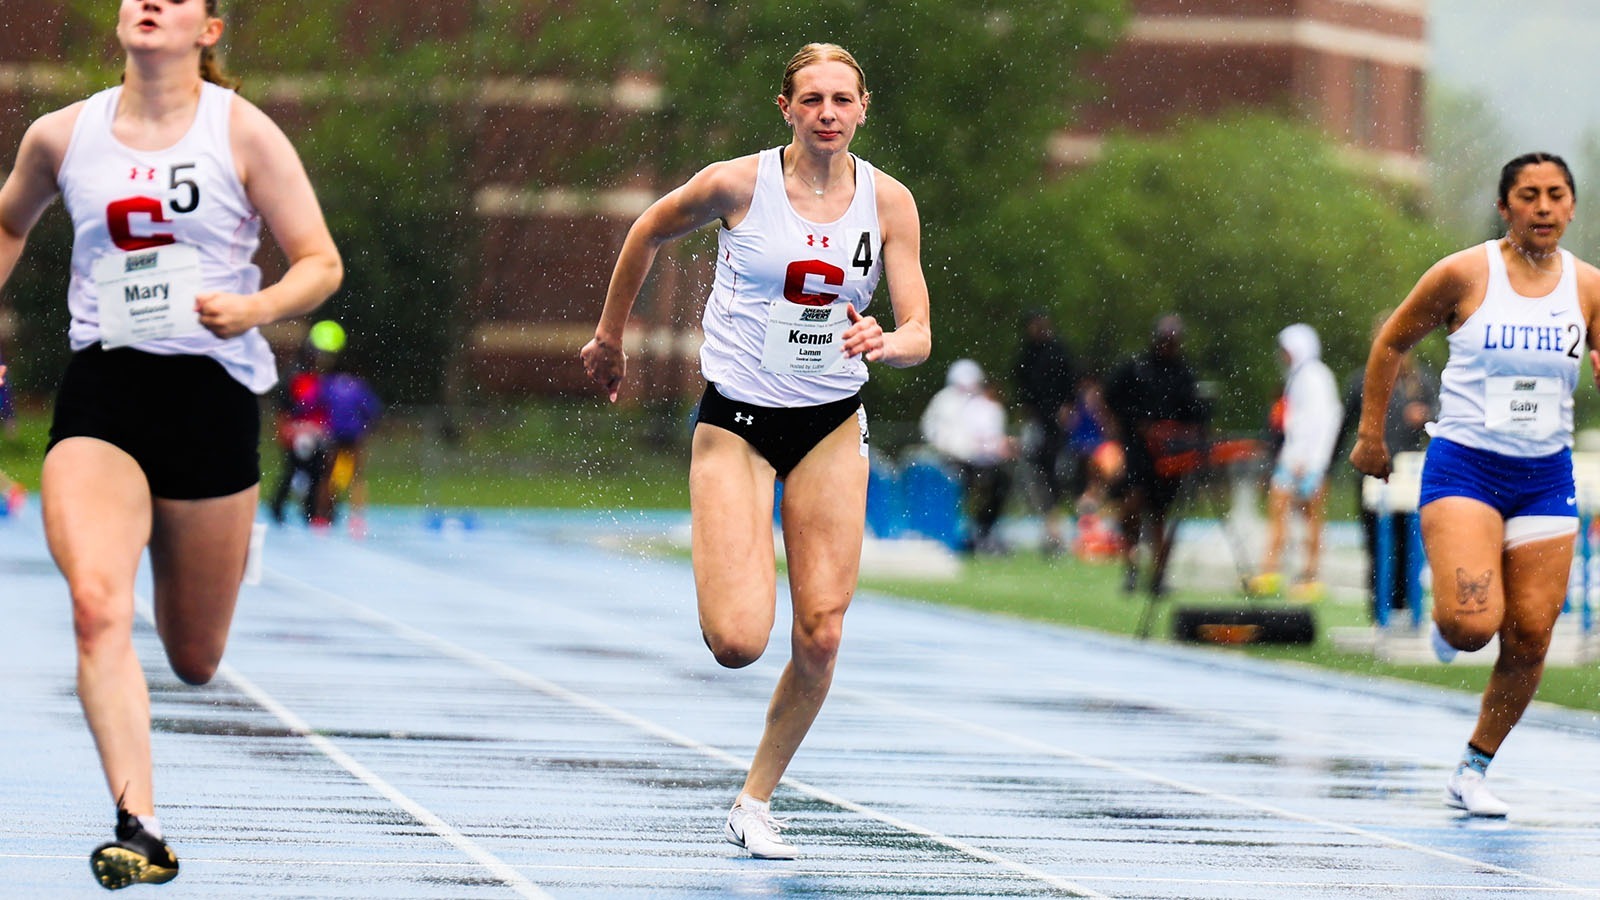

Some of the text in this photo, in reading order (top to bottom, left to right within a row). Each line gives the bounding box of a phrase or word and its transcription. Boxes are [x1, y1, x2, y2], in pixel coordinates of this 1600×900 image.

[169, 162, 200, 214] 5
[106, 196, 176, 252] C
[852, 231, 873, 277] 4
[124, 282, 169, 303] Mary
[783, 259, 845, 307] C
[788, 329, 833, 345] Kenna
[799, 348, 822, 357] Lamm
[1483, 324, 1565, 352] LUTHE
[1567, 324, 1581, 360] 2
[1510, 400, 1538, 414] Gaby
